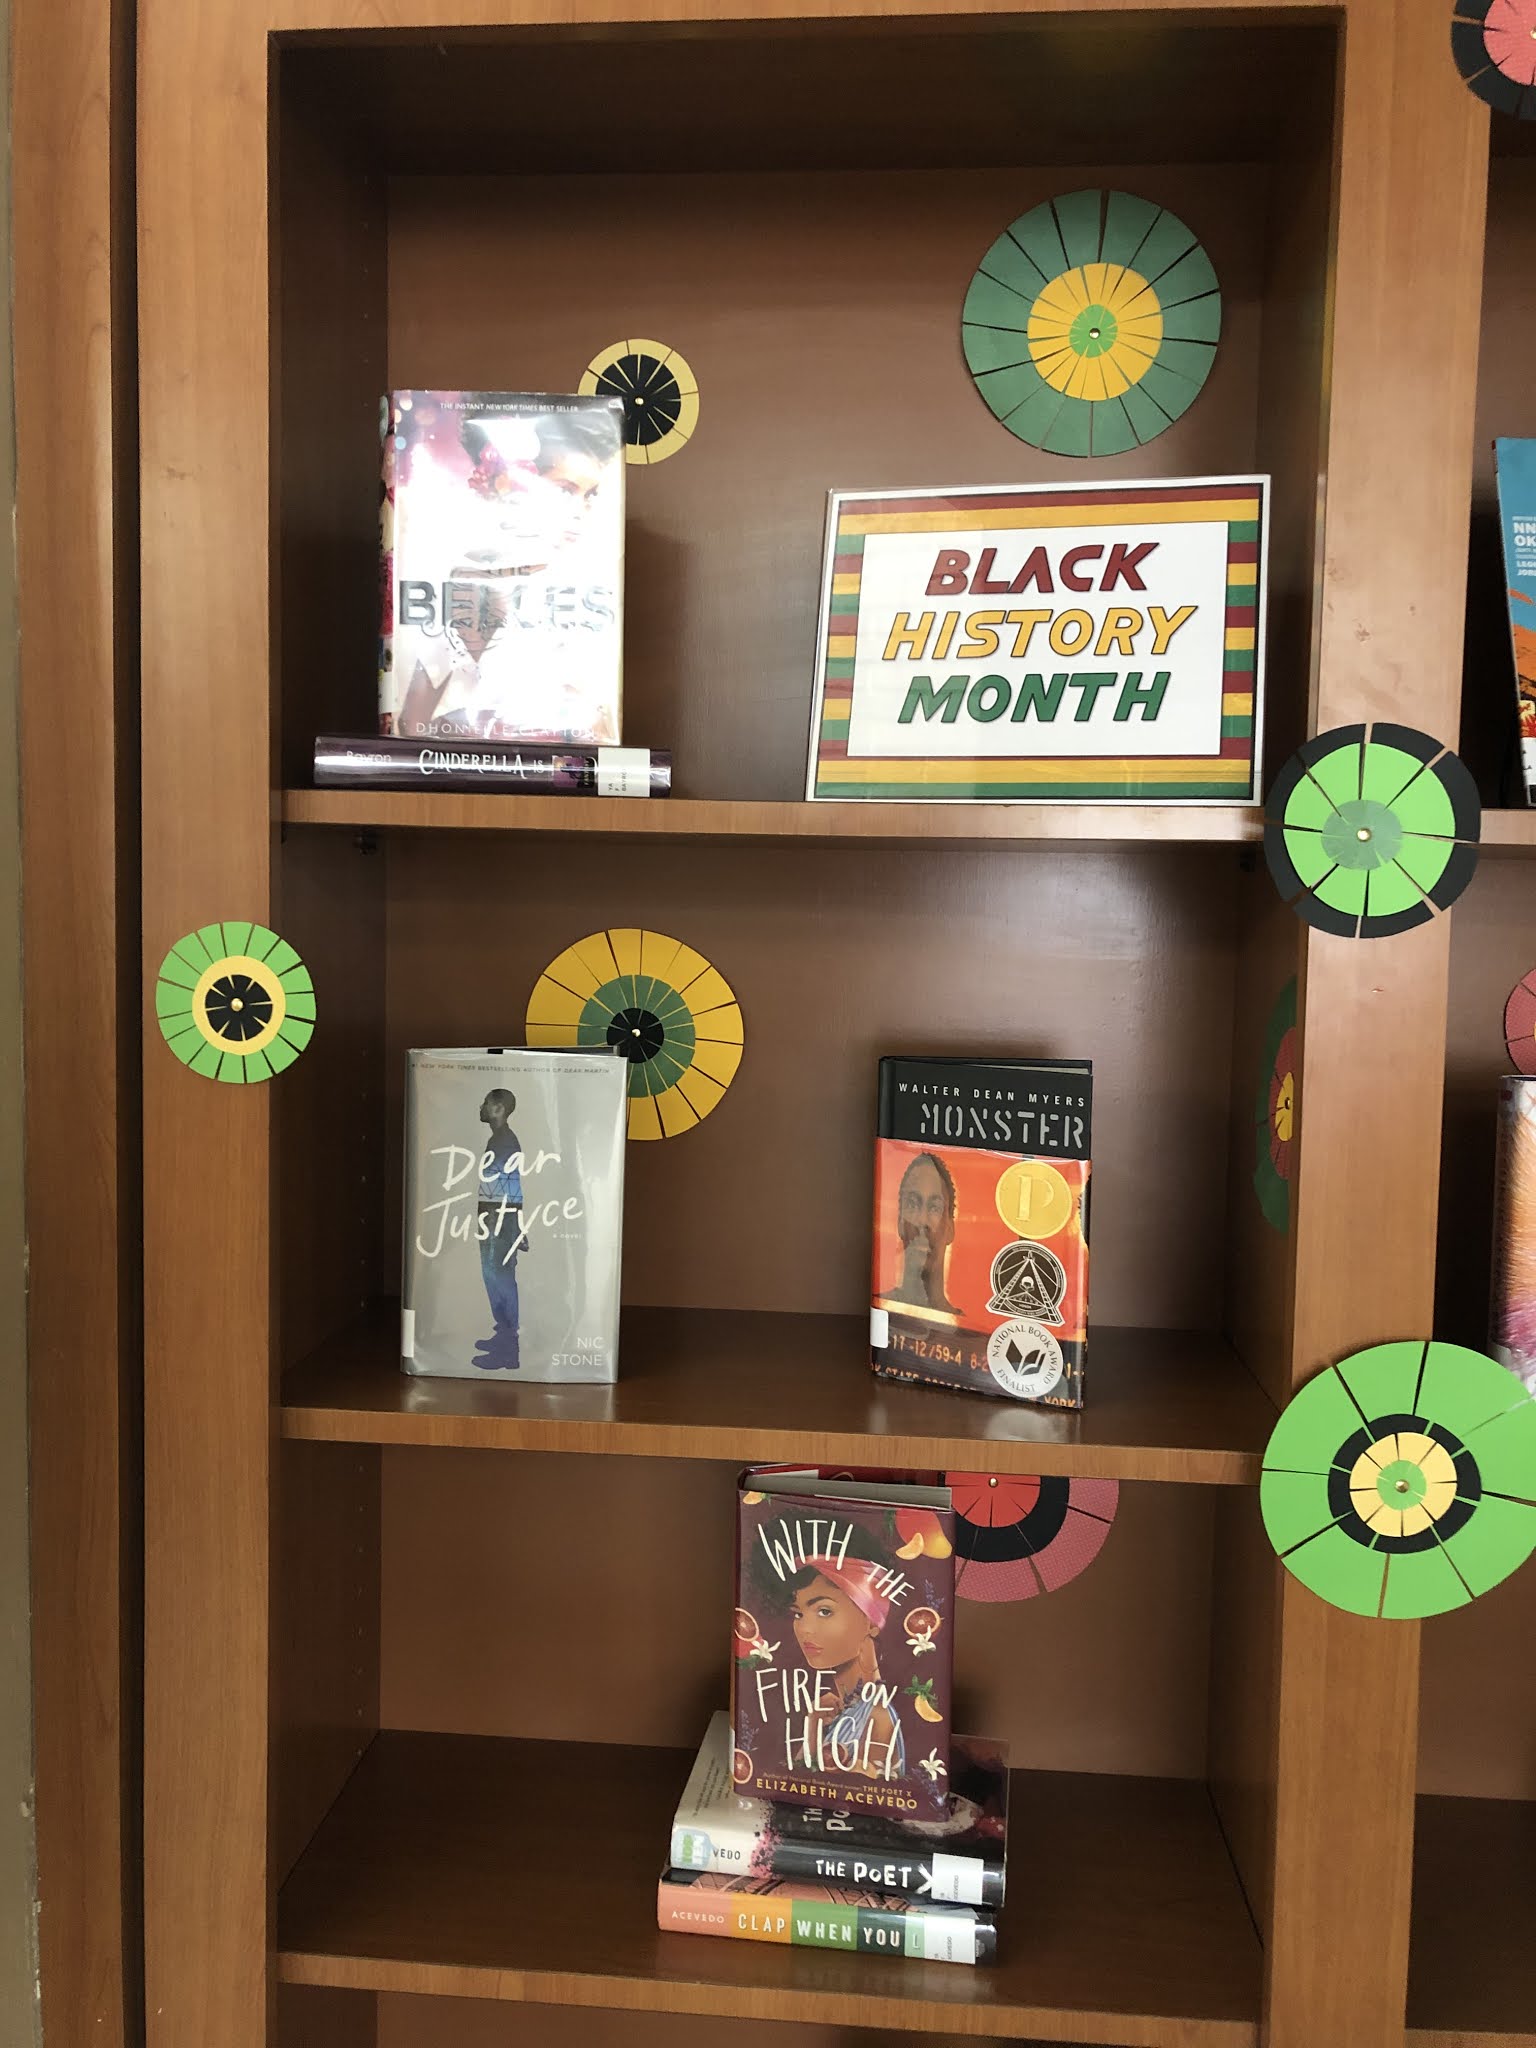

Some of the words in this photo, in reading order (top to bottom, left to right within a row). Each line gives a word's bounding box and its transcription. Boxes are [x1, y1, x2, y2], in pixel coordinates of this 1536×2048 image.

[440, 402, 454, 410] THE
[455, 403, 484, 411] INSTANT
[486, 403, 501, 411] NEW
[519, 404, 537, 412] TIMES
[539, 404, 554, 412] BEST
[556, 405, 579, 413] SELLER
[924, 542, 1160, 596] BLACK
[881, 606, 1199, 661] HISTORY
[897, 671, 1171, 725] MONTH
[899, 1082, 960, 1097] WALTER
[973, 1088, 1015, 1101] DEAN
[1028, 1093, 1085, 1107] MYERS
[920, 1102, 1085, 1149] MONSTER
[430, 1144, 562, 1191] Dear
[416, 1191, 584, 1267] Justyce
[551, 1353, 603, 1367] STONE
[577, 1336, 603, 1350] NIC
[992, 1324, 1026, 1358] NATIONAL
[1028, 1326, 1053, 1349] BOOK
[1043, 1349, 1058, 1385] AWARD
[997, 1368, 1036, 1393] FINALIST
[758, 1518, 854, 1582] WITH
[867, 1560, 915, 1606] THE
[755, 1667, 837, 1723] FIRE
[861, 1681, 898, 1709] ON
[785, 1715, 901, 1782] HIGH
[756, 1778, 837, 1799] ELIZABETH
[845, 1791, 918, 1809] ACEVEDO
[863, 1785, 878, 1794] THE
[881, 1787, 903, 1796] POET
[906, 1790, 912, 1798] X
[713, 1848, 741, 1860] VEDO
[816, 1859, 846, 1877] THE
[671, 1911, 725, 1924] ACEVEDO
[738, 1913, 785, 1933] CLAP
[796, 1919, 852, 1942] WHEN
[863, 1927, 900, 1947] YOU
